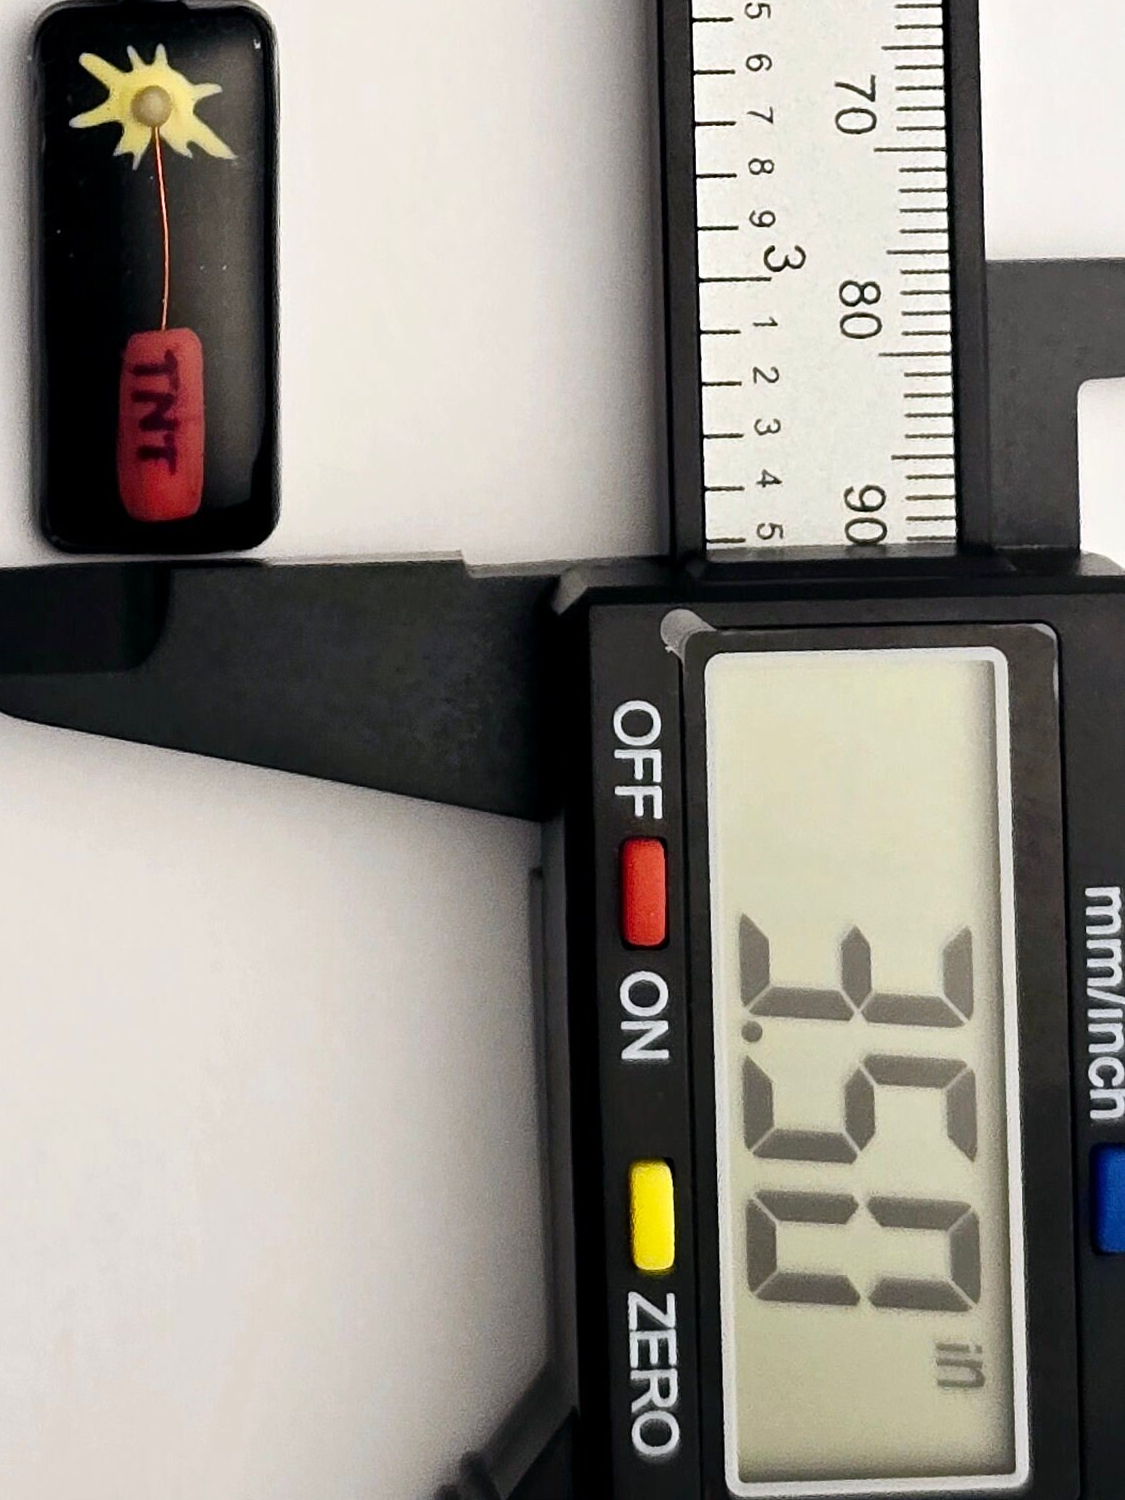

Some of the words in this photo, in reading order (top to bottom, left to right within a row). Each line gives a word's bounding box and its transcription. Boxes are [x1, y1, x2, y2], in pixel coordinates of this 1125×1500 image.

[744, 2, 771, 19] 5
[746, 54, 772, 72] 6
[747, 107, 774, 124] 7
[834, 75, 877, 135] 70
[748, 158, 775, 175] 8
[749, 210, 776, 228] 9
[763, 245, 806, 272] 3
[839, 280, 883, 339] 80
[753, 317, 778, 327] 1
[753, 367, 779, 384] 2
[130, 348, 180, 475] TNT
[754, 419, 781, 436] 3
[756, 469, 782, 488] 4
[844, 485, 888, 546] 90
[756, 523, 783, 540] 5
[613, 700, 662, 819] OFF
[1084, 886, 1125, 1120] mm/inch
[620, 971, 669, 1061] ON
[738, 912, 982, 1313] 3.50
[934, 1340, 986, 1390] in
[628, 1292, 680, 1457] ZERO
